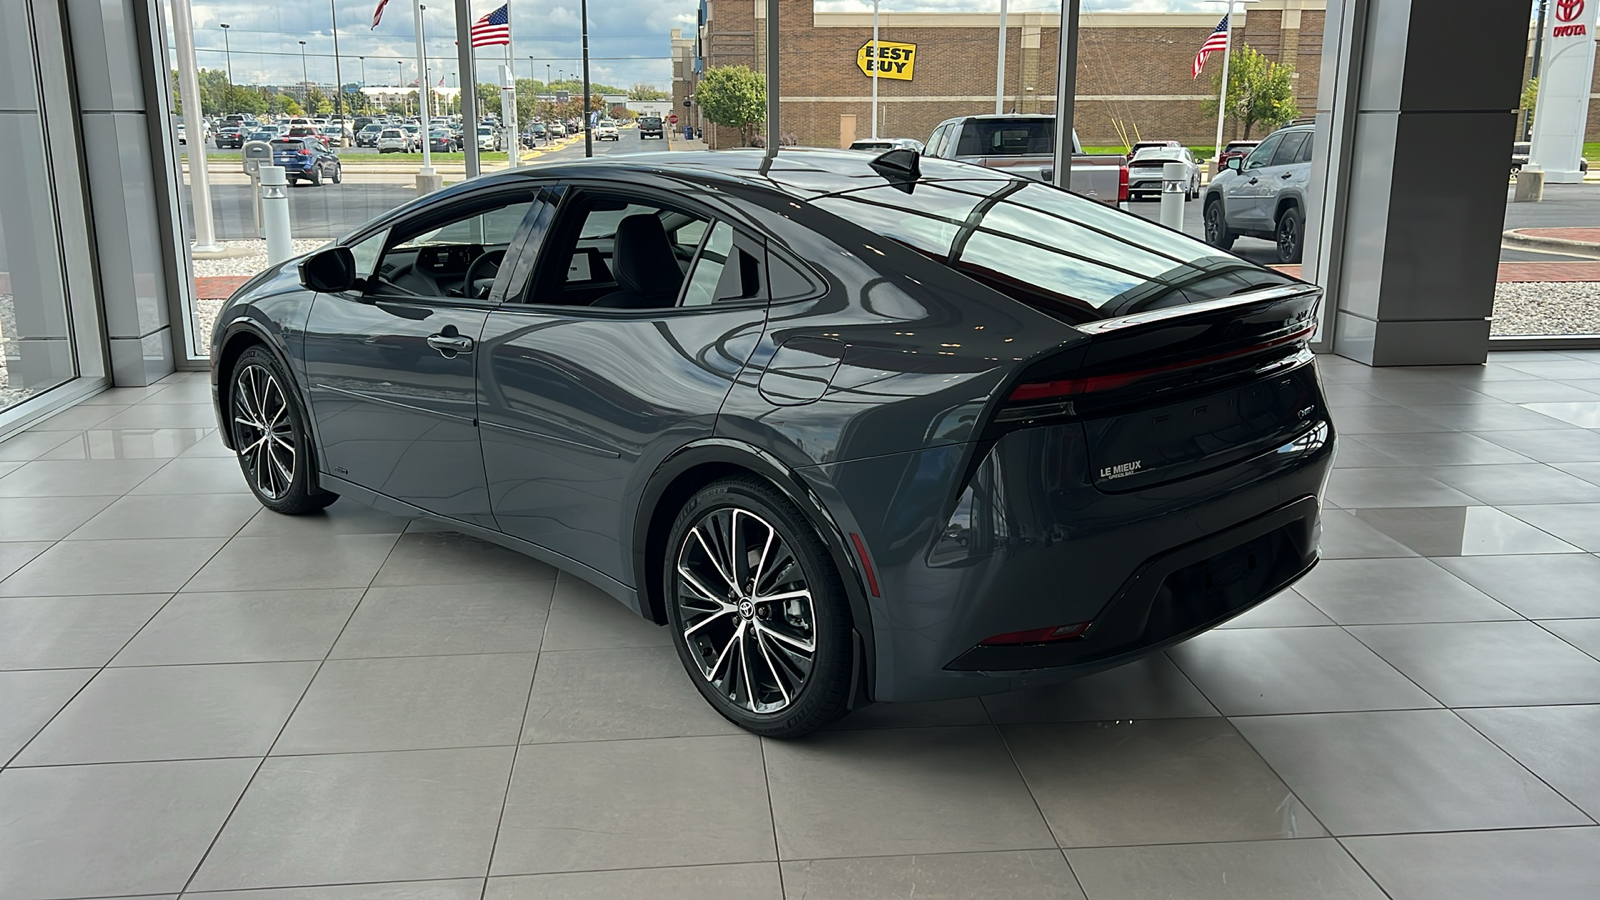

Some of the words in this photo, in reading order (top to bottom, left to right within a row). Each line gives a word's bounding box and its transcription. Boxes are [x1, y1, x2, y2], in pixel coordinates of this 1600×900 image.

[1553, 24, 1586, 37] OYOTA
[866, 46, 913, 61] BEST
[867, 60, 908, 74] BUY
[1100, 467, 1112, 477] LE
[1113, 460, 1141, 474] MIEUX
